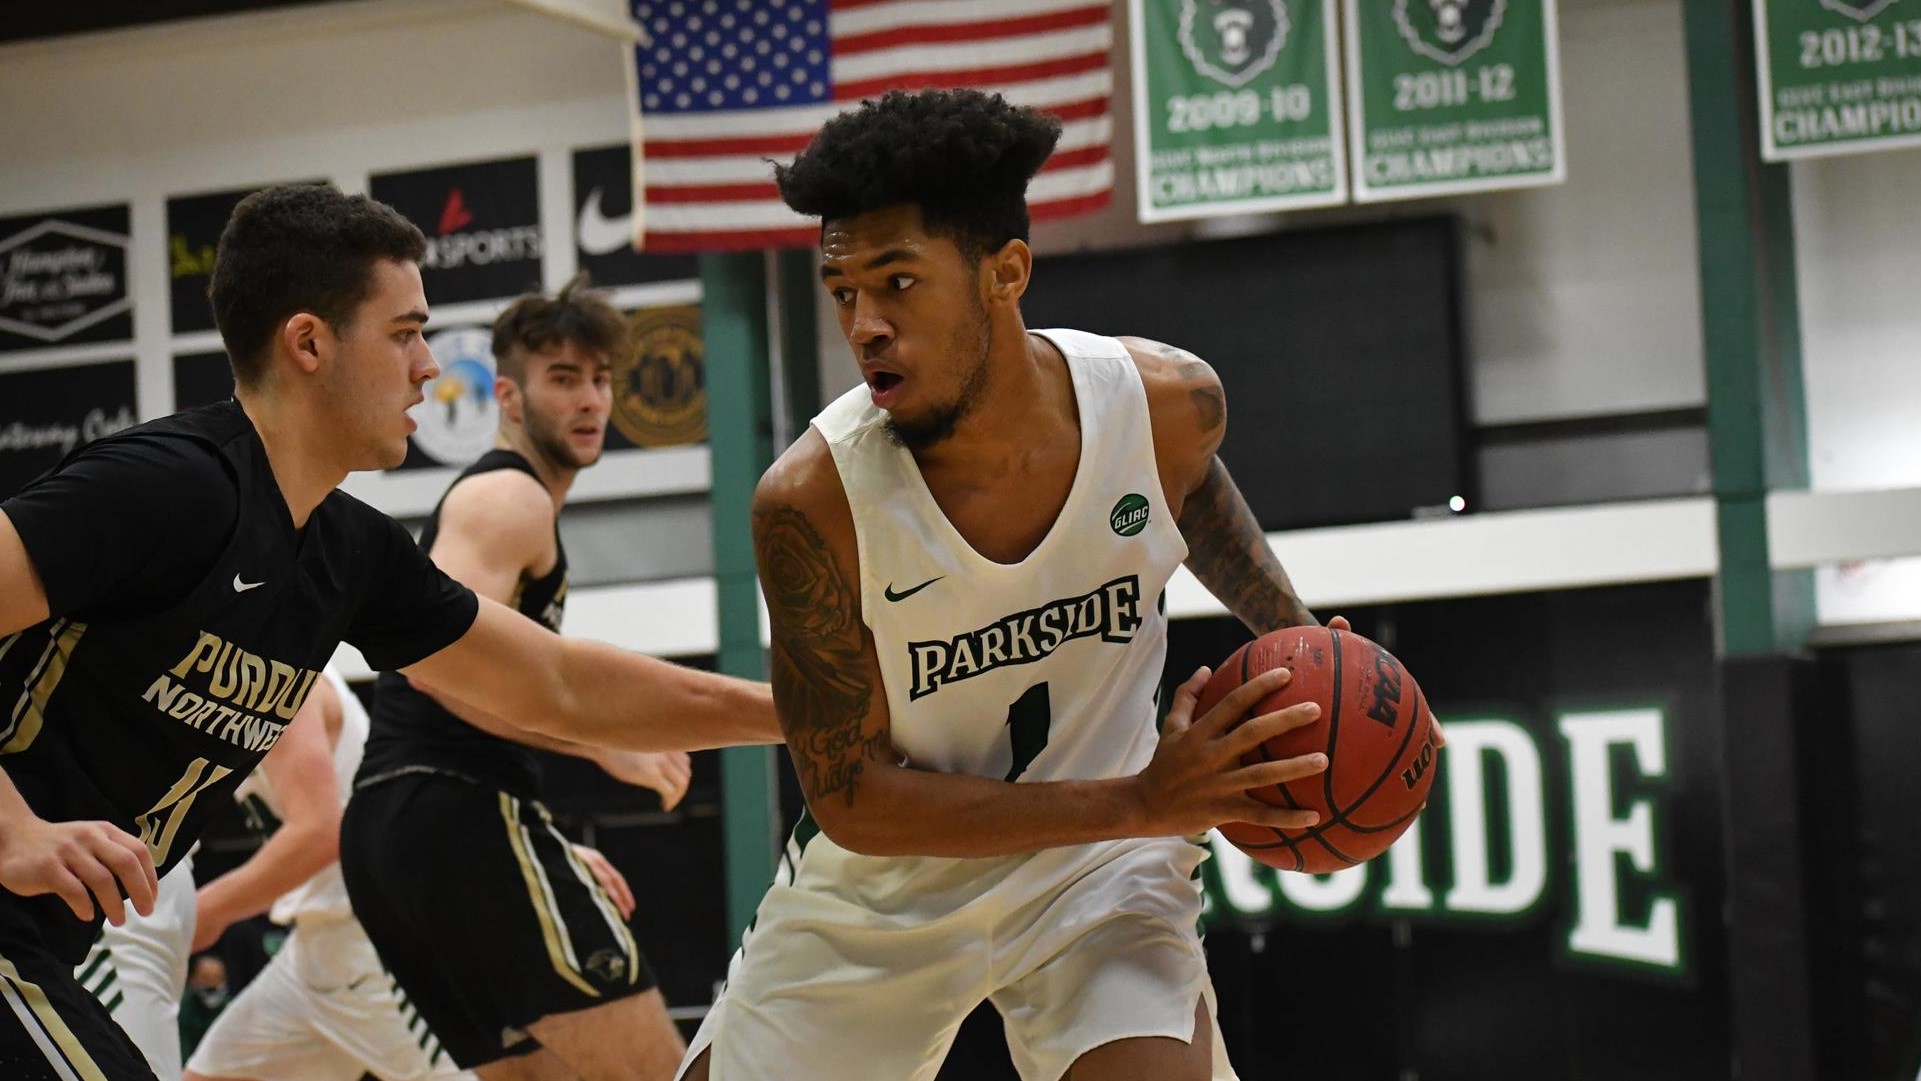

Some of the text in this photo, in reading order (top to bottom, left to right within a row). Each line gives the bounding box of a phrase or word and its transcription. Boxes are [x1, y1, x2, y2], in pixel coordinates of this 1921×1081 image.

[1799, 19, 1921, 69] 2012-13
[1166, 84, 1311, 134] 2009-10
[1392, 63, 1517, 112] 2011-12
[1151, 160, 1336, 206] CHAMPIONS
[1365, 137, 1553, 187] CHAMPIONS
[1114, 505, 1148, 530] GLIAC
[908, 574, 1143, 702] PARKSIDE
[141, 674, 288, 752] NORTHWE
